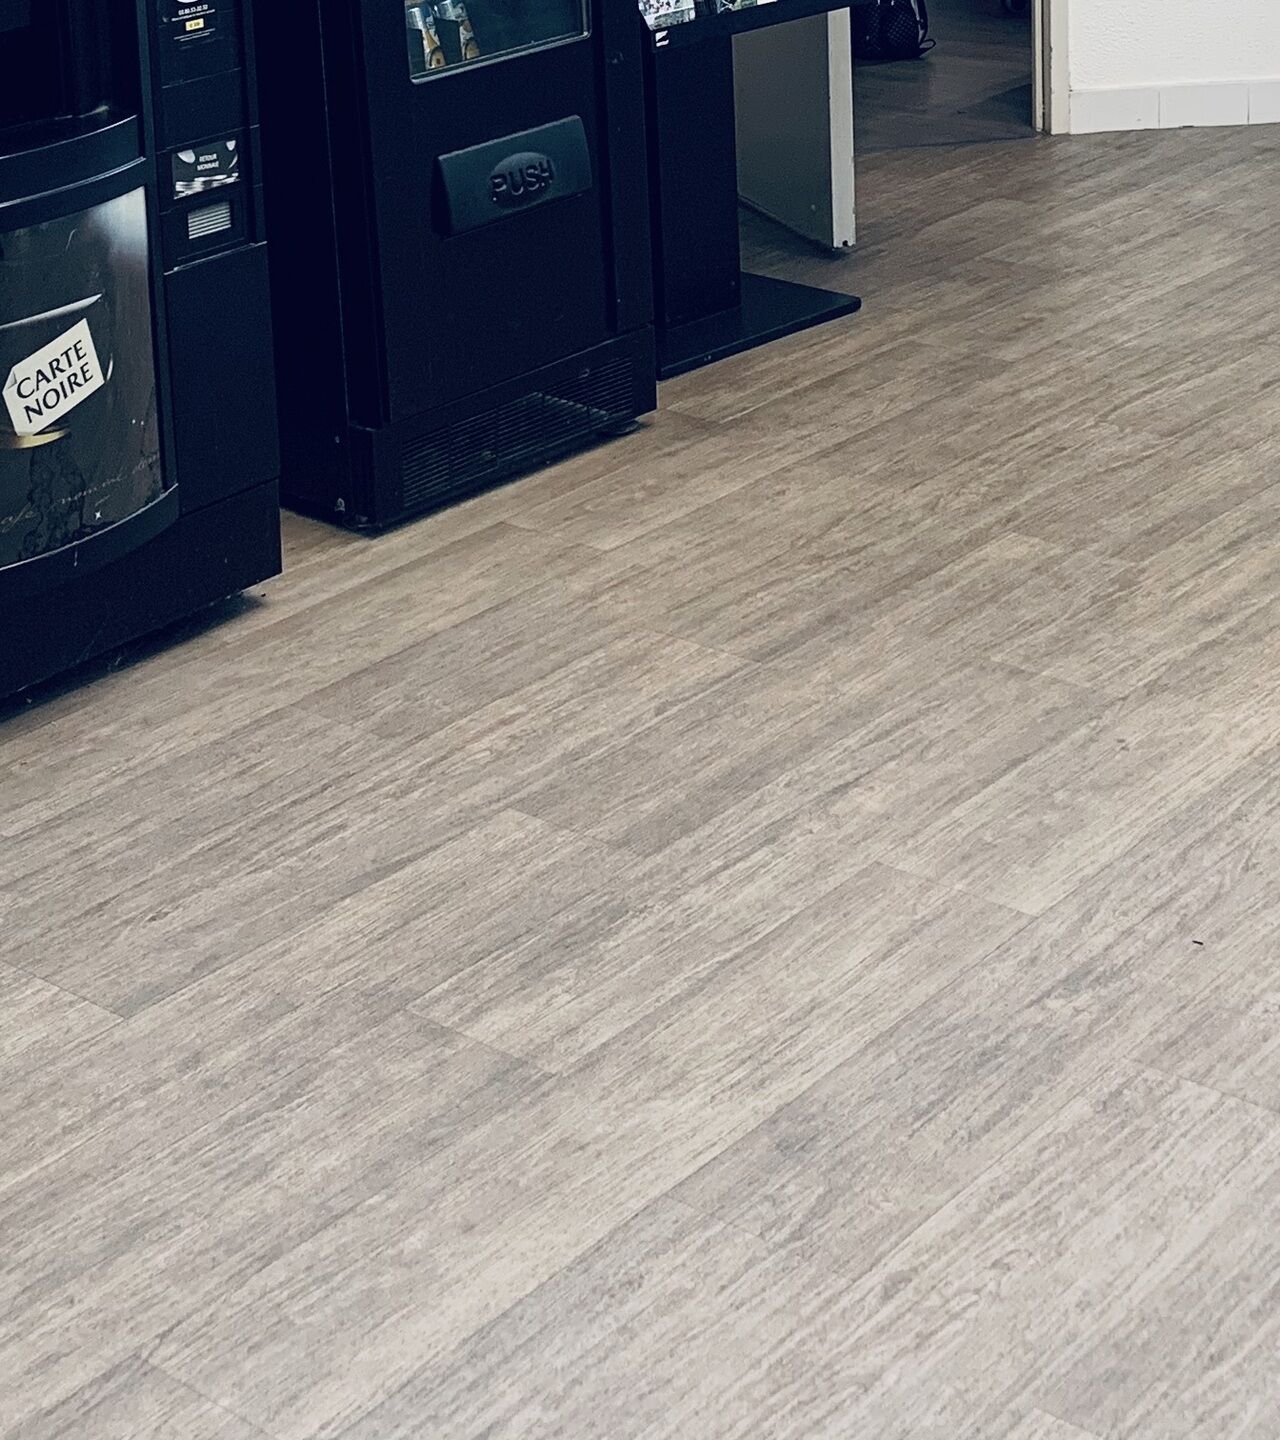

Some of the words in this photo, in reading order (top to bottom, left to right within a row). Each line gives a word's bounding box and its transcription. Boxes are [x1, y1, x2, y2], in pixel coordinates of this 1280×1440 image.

[490, 158, 554, 202] PUSH
[17, 340, 87, 399] CARTE
[24, 362, 93, 424] NOIRE
